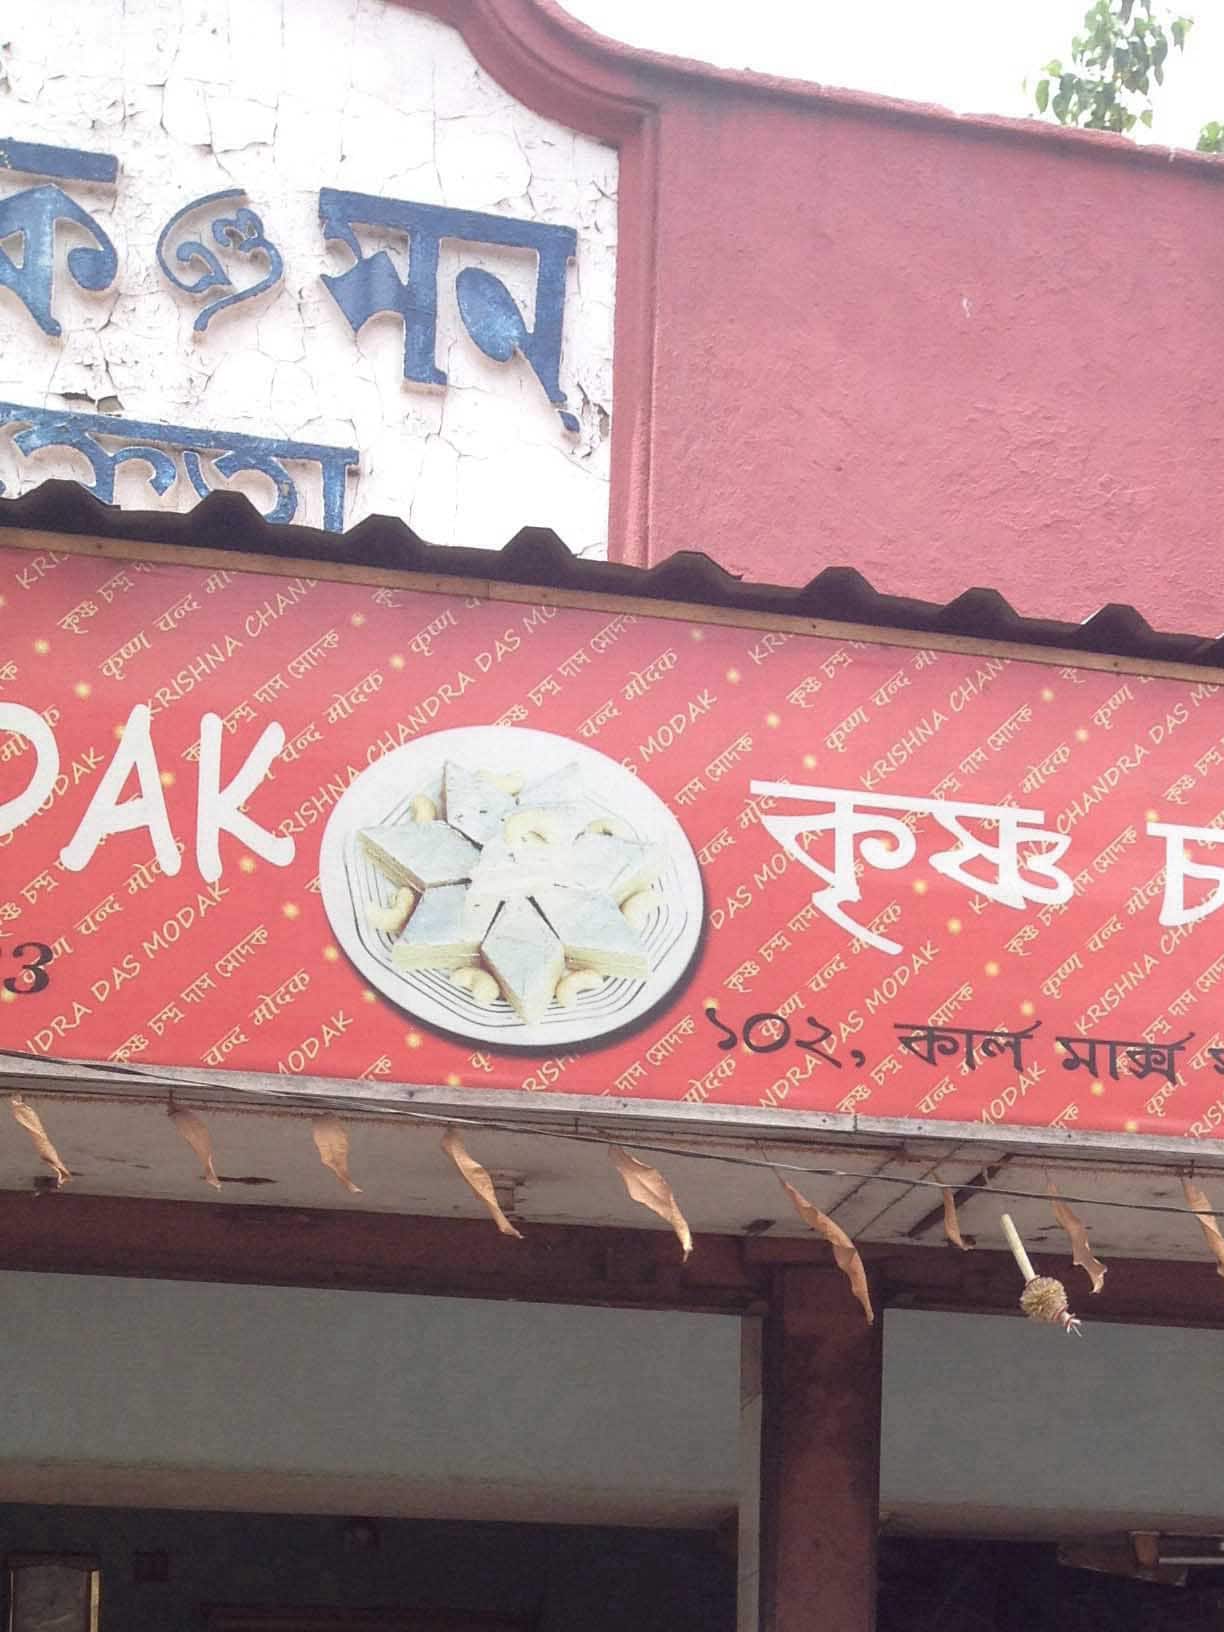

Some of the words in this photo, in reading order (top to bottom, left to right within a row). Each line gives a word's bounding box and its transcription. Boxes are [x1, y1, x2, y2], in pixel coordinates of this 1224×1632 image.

[148, 635, 244, 720] KRISHNA
[475, 628, 521, 672] DAS
[639, 688, 718, 764] MODAK
[859, 709, 949, 790] KRISHNA
[1056, 744, 1150, 834] CHANDRA
[1151, 703, 1189, 745] DAS
[750, 778, 1074, 955] কৃষ্ণ
[91, 954, 142, 1002] DAS
[142, 882, 232, 960] MODAK
[711, 888, 752, 930] DAS
[864, 941, 941, 1014] MODAK
[1074, 953, 1160, 1036] KRISHNA
[705, 1008, 865, 1069] ১০২,
